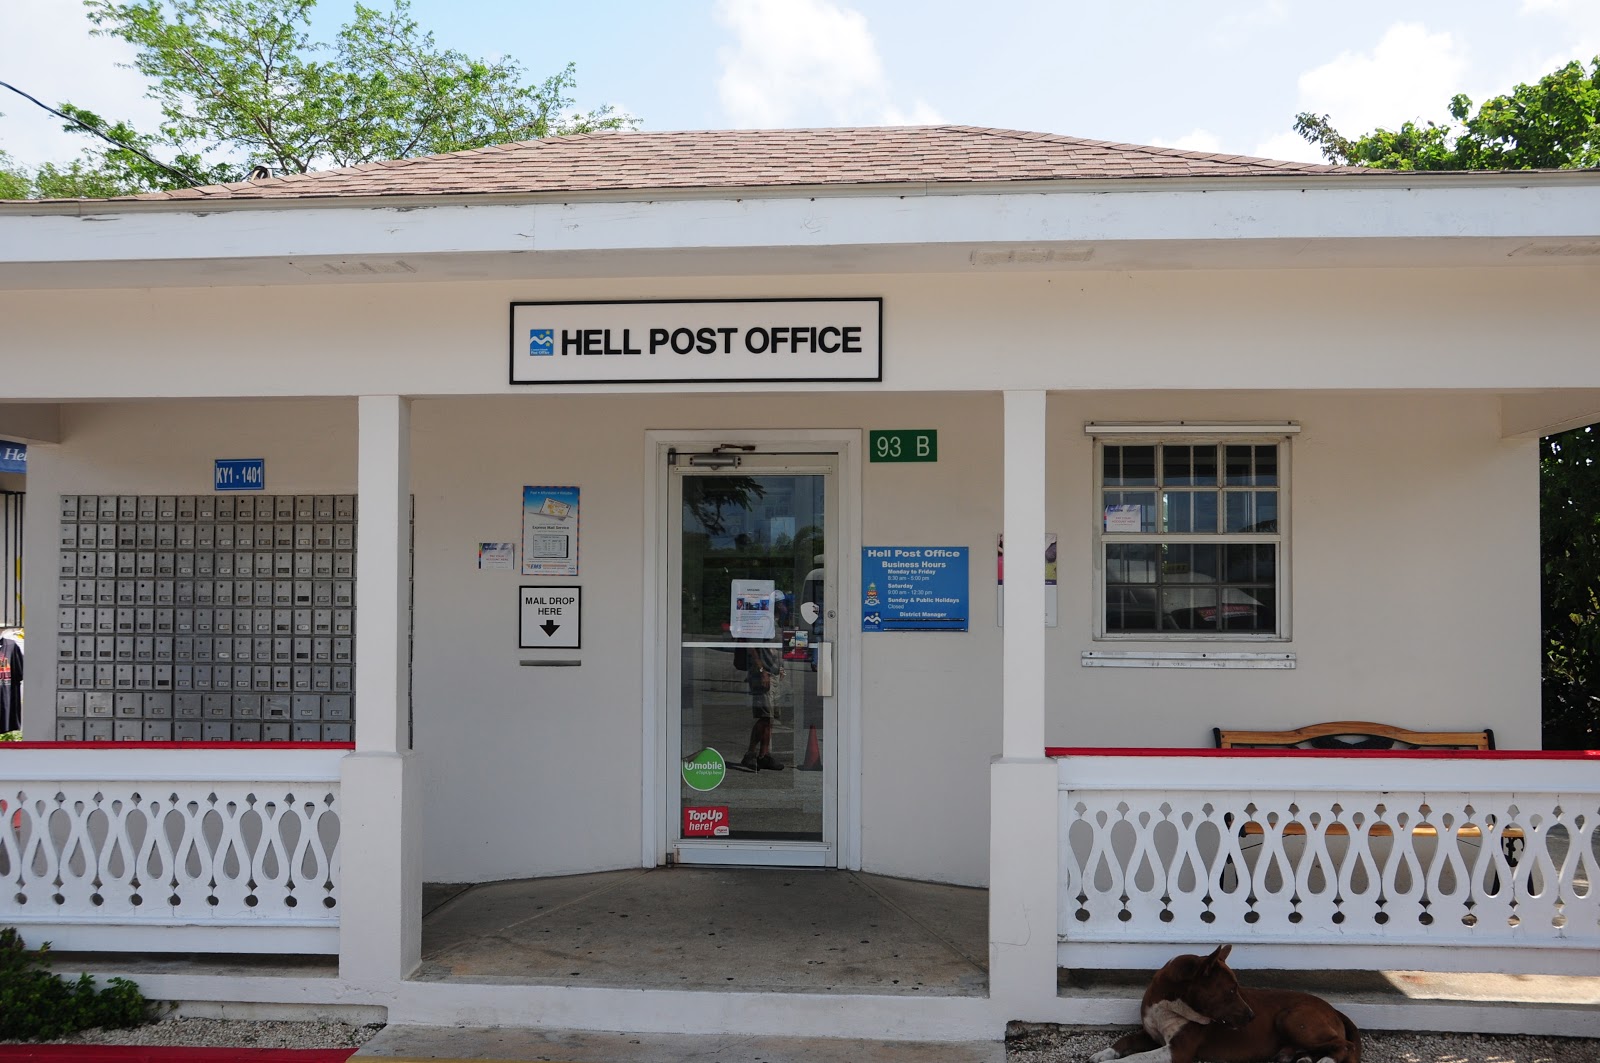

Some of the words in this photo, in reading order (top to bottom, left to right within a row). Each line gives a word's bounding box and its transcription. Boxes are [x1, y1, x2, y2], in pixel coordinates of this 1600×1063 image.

[561, 329, 641, 356] HELL
[649, 328, 738, 355] POST
[745, 326, 863, 354] OFFICE
[877, 436, 902, 457] 93
[916, 435, 930, 457] B
[216, 467, 233, 484] KY1
[241, 466, 261, 484] 1401
[867, 549, 891, 557] Hell
[894, 549, 921, 558] Post
[924, 549, 960, 558] Office
[525, 597, 547, 605] MAIL
[549, 597, 575, 605] DROP
[537, 608, 563, 616] HERE
[688, 809, 723, 823] TopUp
[688, 821, 713, 831] here!
